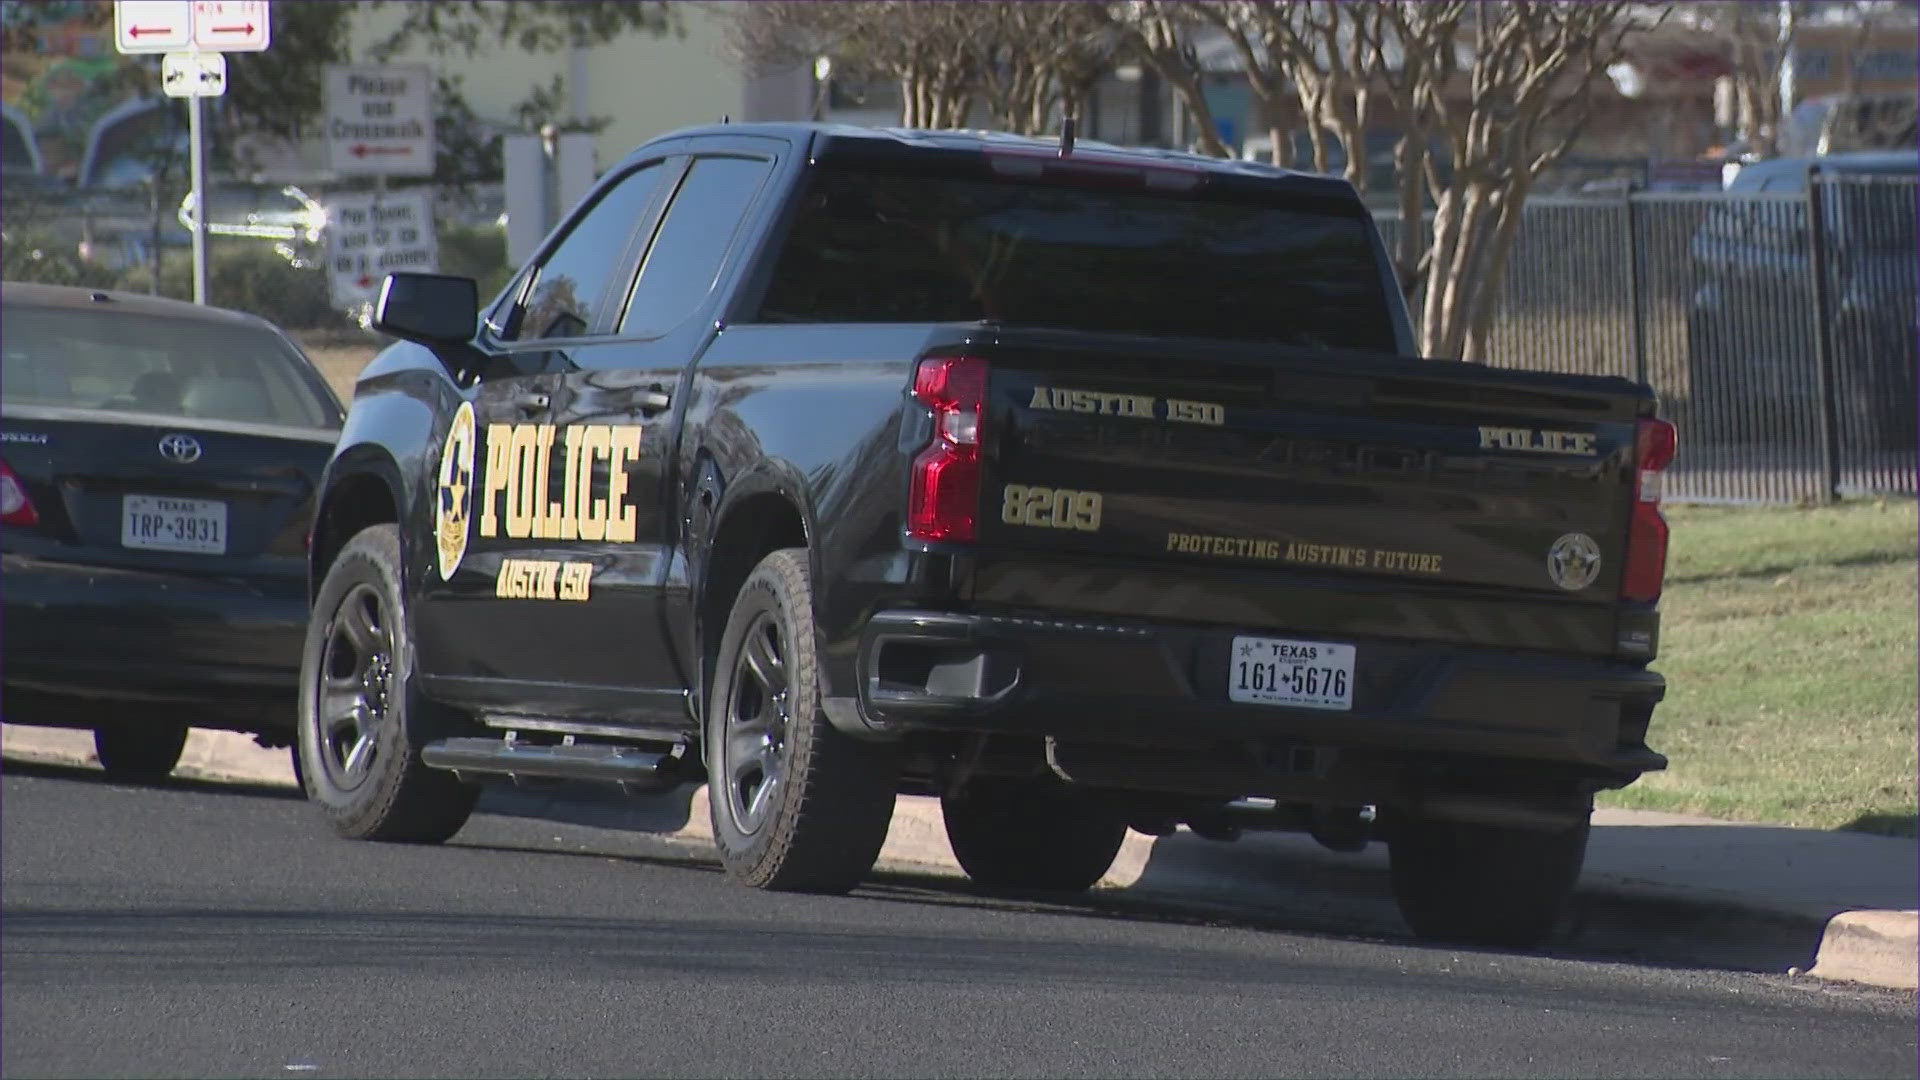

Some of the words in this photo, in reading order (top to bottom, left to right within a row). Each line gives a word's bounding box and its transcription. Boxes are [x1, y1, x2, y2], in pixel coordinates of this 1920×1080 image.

[349, 76, 406, 95] Please
[333, 118, 423, 138] Crosswalk
[1029, 386, 1155, 418] AUSTIN
[1166, 398, 1224, 424] ISD
[1478, 426, 1597, 456] POLICE
[480, 423, 643, 542] POLICE
[157, 500, 195, 512] TEXAS
[1001, 484, 1103, 530] 8209
[1166, 532, 1279, 560] PROTECTING
[1285, 543, 1366, 567] AUSTIN'S
[1372, 549, 1443, 572] FUTURE
[495, 558, 561, 600] AUSTIN
[560, 561, 593, 601] ISD
[1272, 644, 1317, 659] TEXAS
